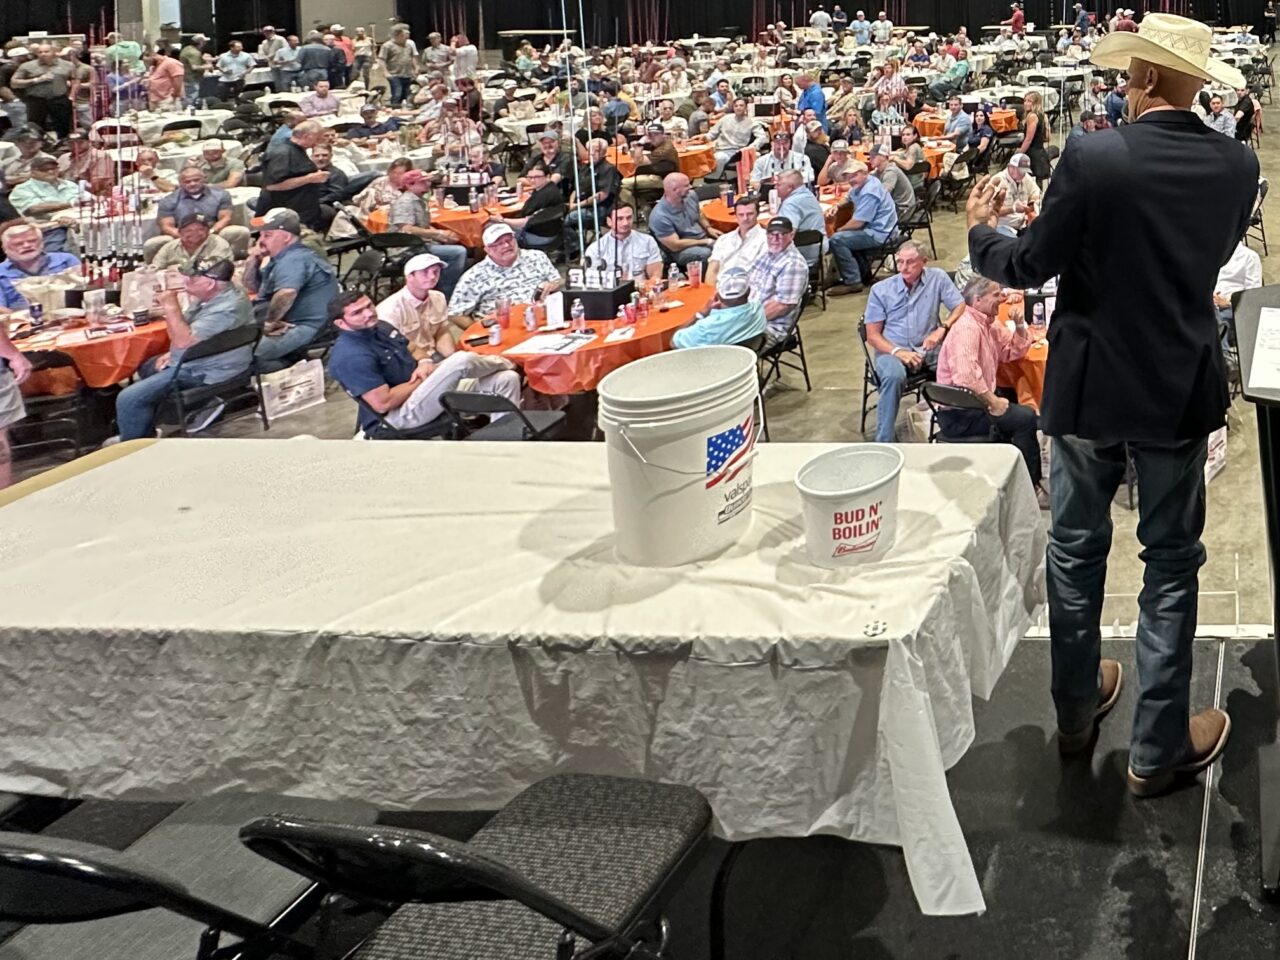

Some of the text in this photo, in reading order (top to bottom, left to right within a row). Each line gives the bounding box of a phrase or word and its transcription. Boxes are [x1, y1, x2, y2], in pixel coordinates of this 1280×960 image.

[834, 500, 882, 525] BUD N'
[832, 515, 882, 540] BOILIN'
